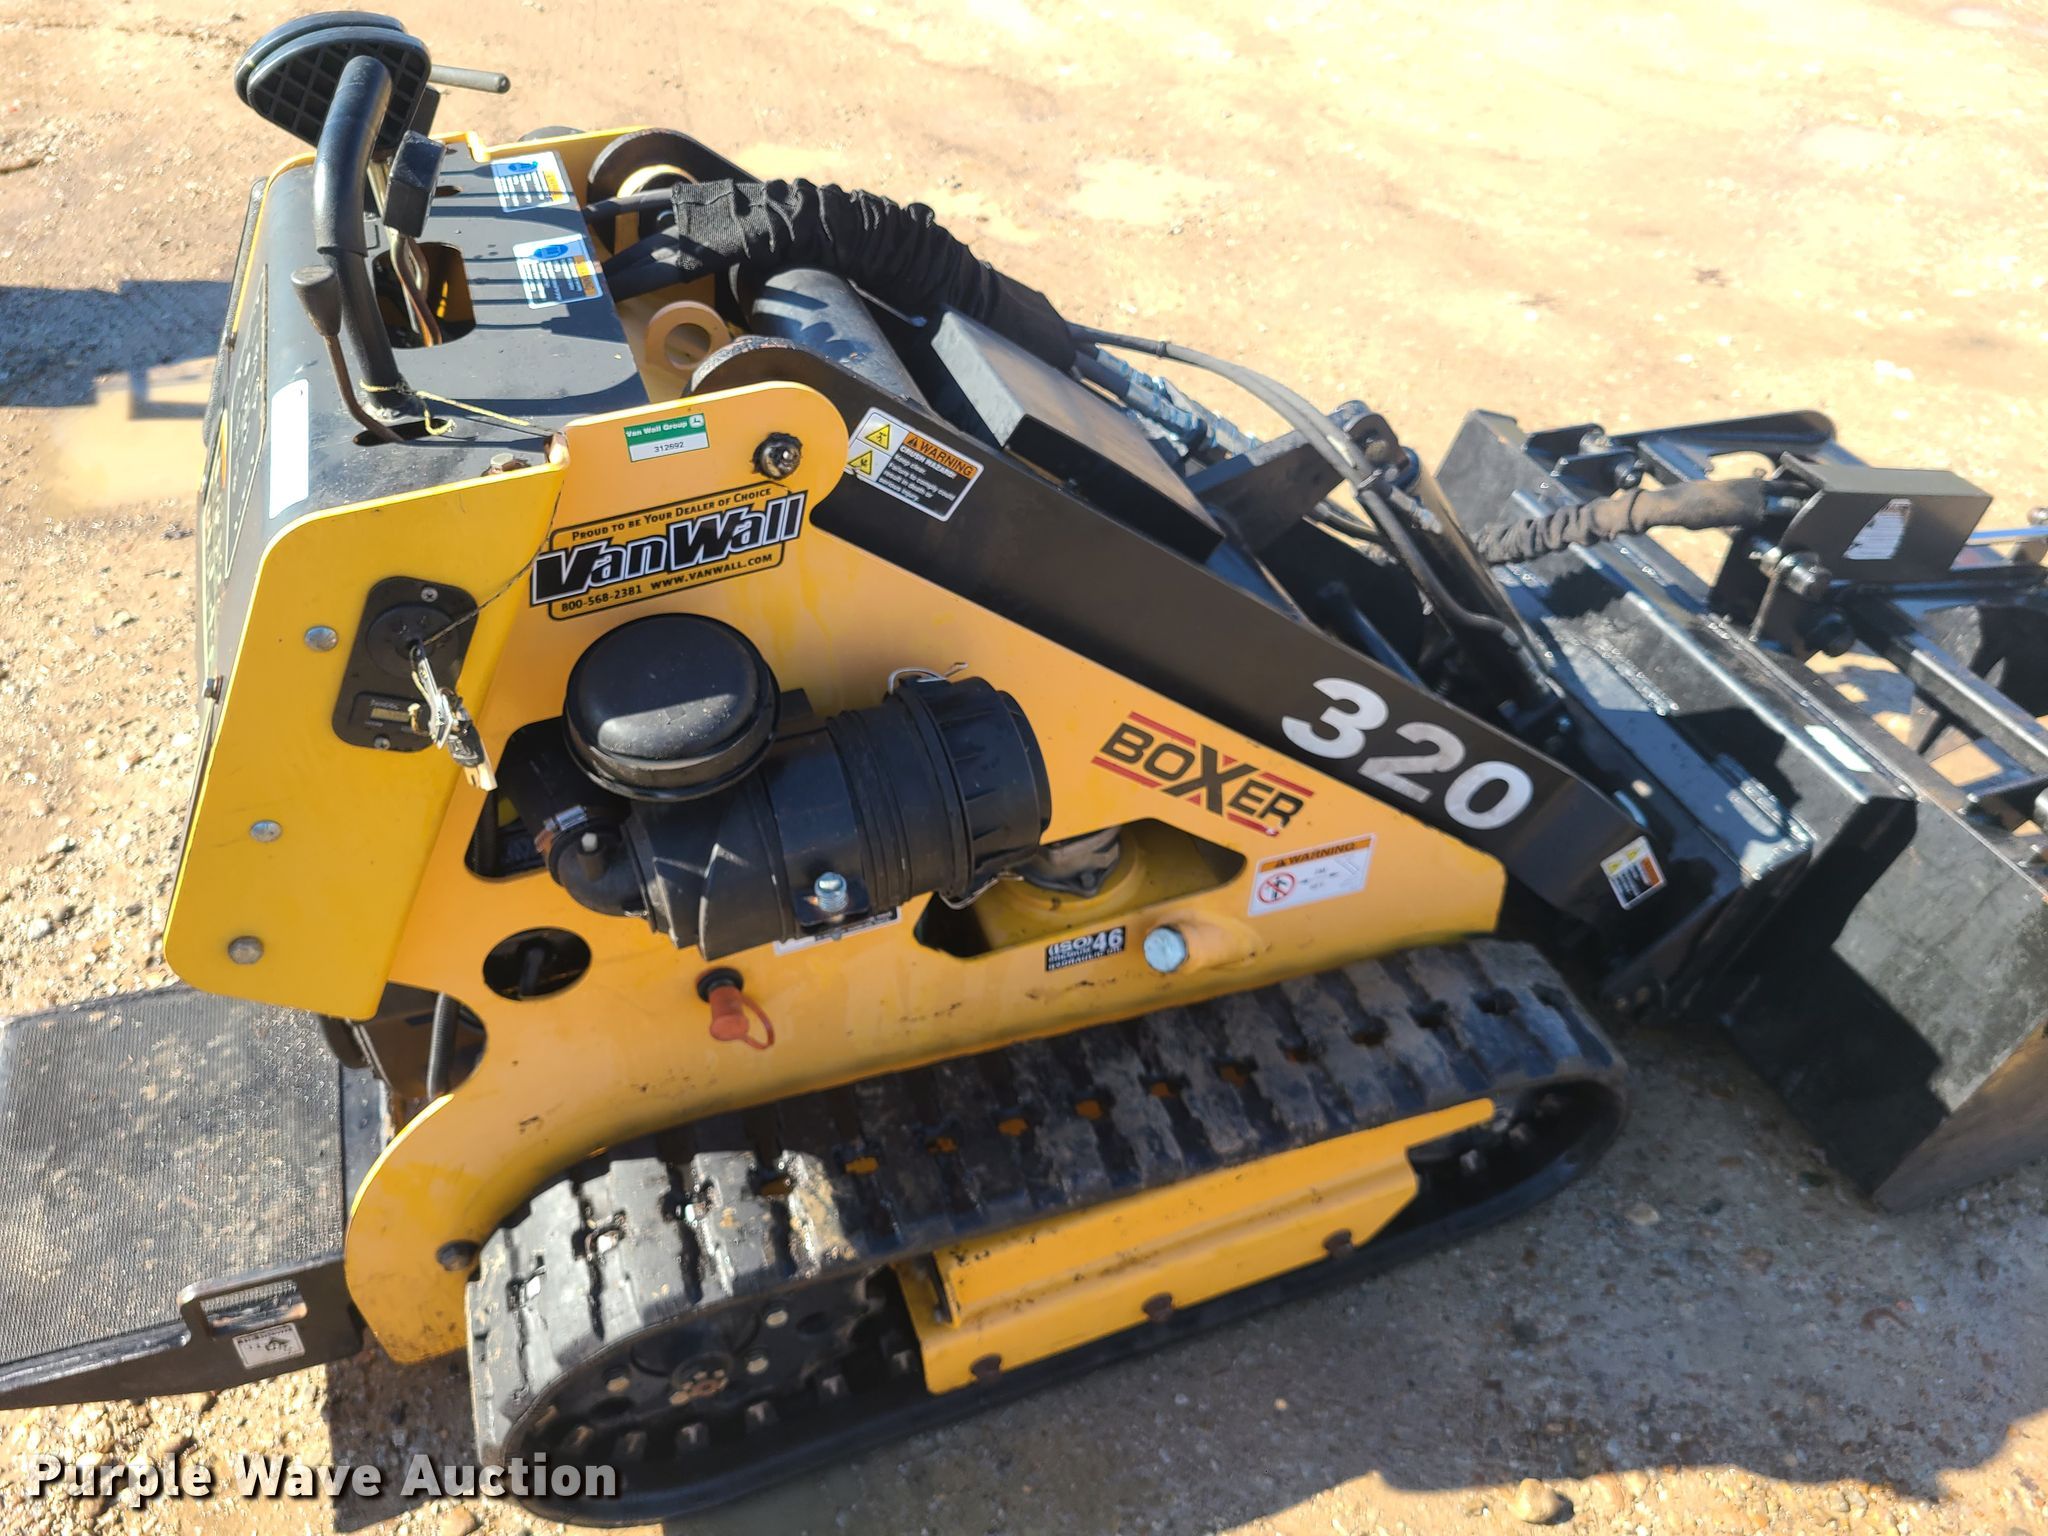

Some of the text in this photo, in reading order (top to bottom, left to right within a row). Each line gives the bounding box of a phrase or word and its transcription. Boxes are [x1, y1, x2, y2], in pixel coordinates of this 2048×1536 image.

[643, 425, 661, 434] Wall
[663, 421, 687, 431] Group
[894, 453, 911, 468] Keep
[921, 441, 974, 477] WARNING
[888, 462, 910, 477] Failure
[916, 478, 938, 493] comply
[937, 488, 957, 502] could
[531, 490, 808, 607] VanWall
[561, 585, 642, 612] 800-568-2381
[1281, 677, 1534, 830] 320
[1100, 722, 1304, 828] BOXER
[1289, 842, 1356, 864] WARNING
